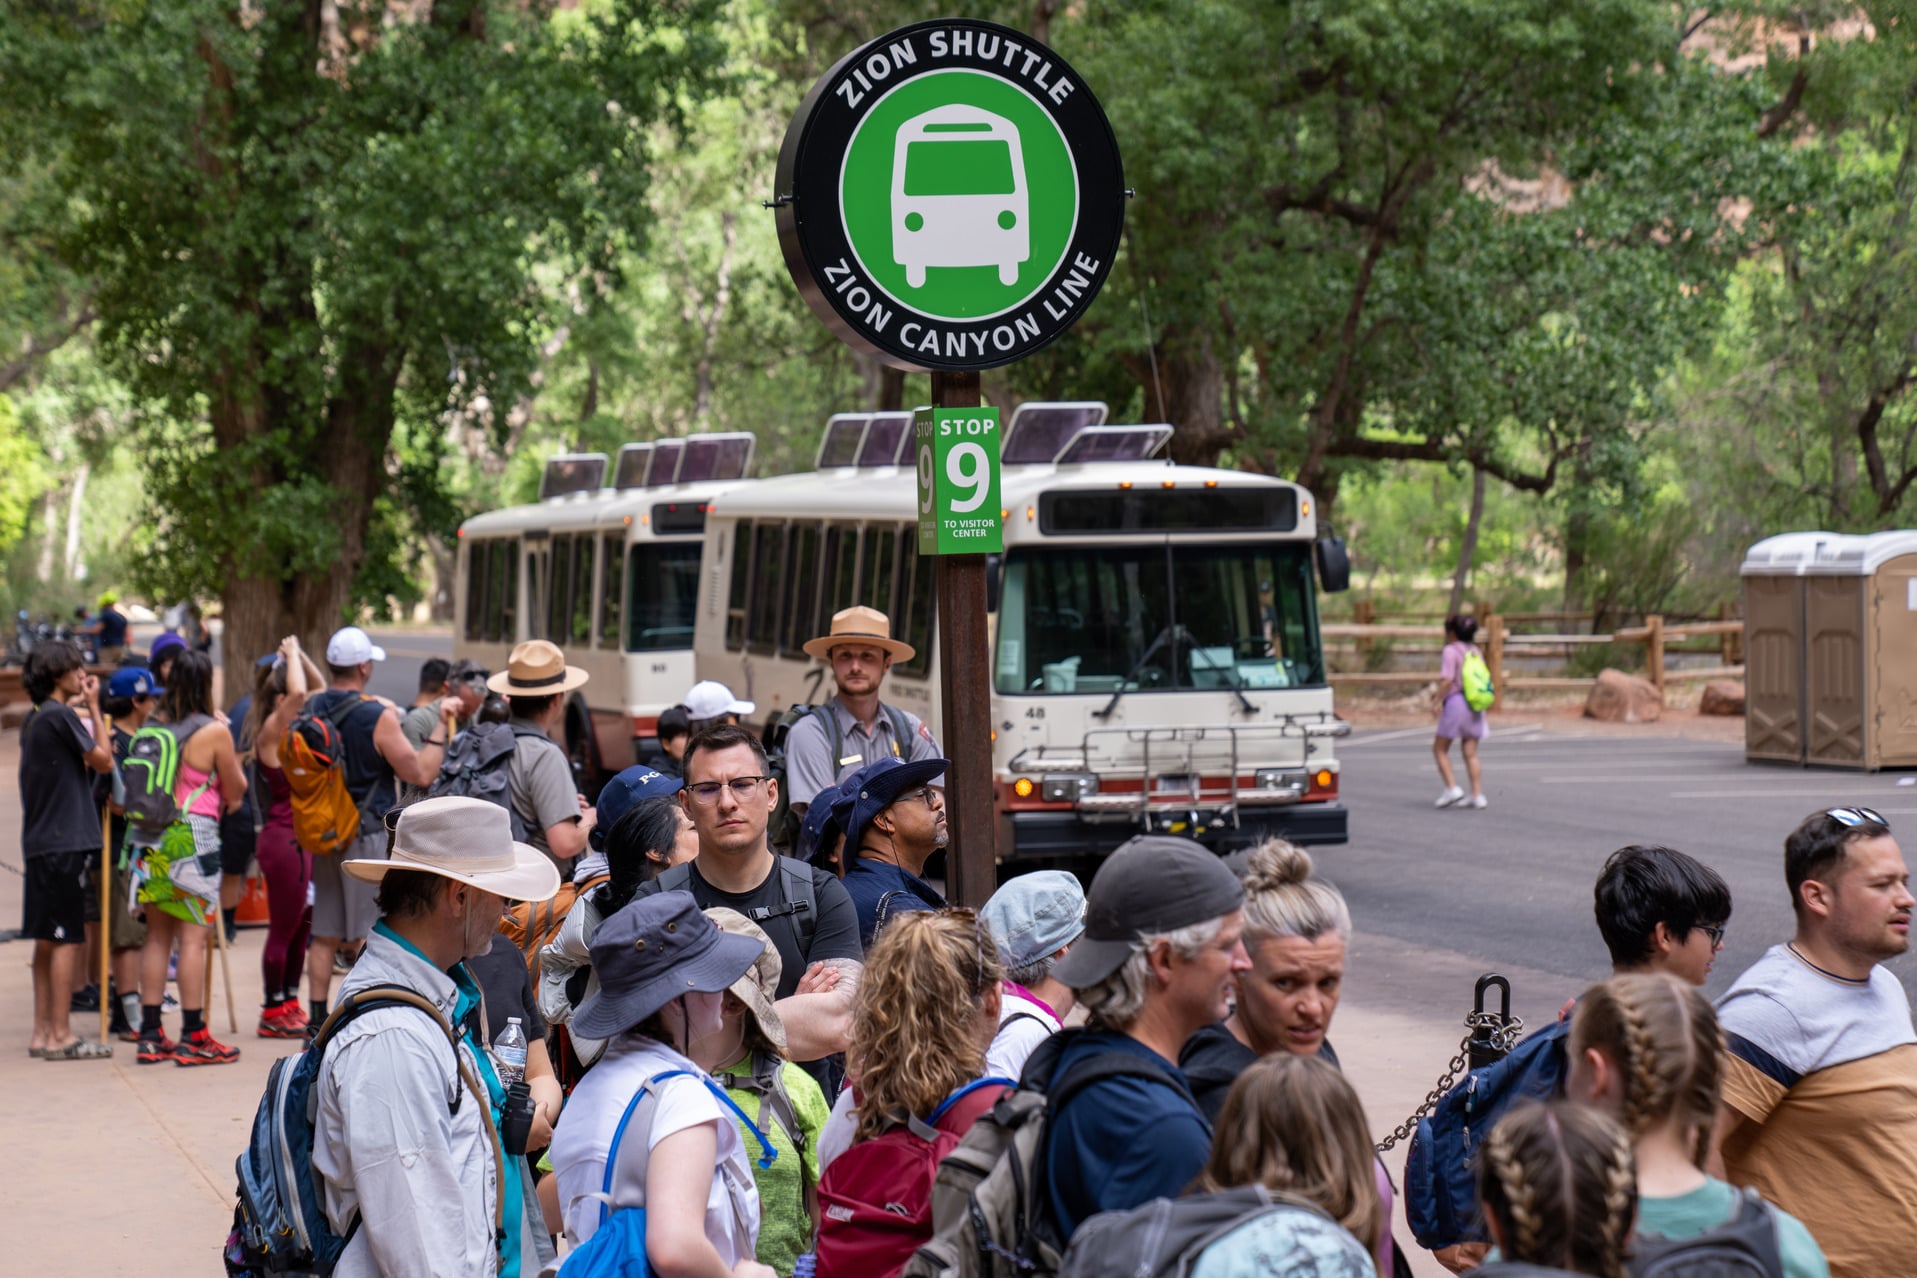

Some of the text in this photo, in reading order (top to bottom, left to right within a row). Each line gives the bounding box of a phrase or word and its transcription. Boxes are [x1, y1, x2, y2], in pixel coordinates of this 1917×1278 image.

[836, 30, 1075, 109] ZION SHUTTLE
[823, 251, 1100, 358] ZION CANYON LINE
[916, 421, 933, 438] STOP
[940, 419, 995, 436] STOP
[919, 444, 934, 514] 9
[946, 441, 990, 513] 9
[944, 520, 957, 528] TO
[959, 519, 995, 528] VISITOR
[952, 529, 987, 537] CENTER
